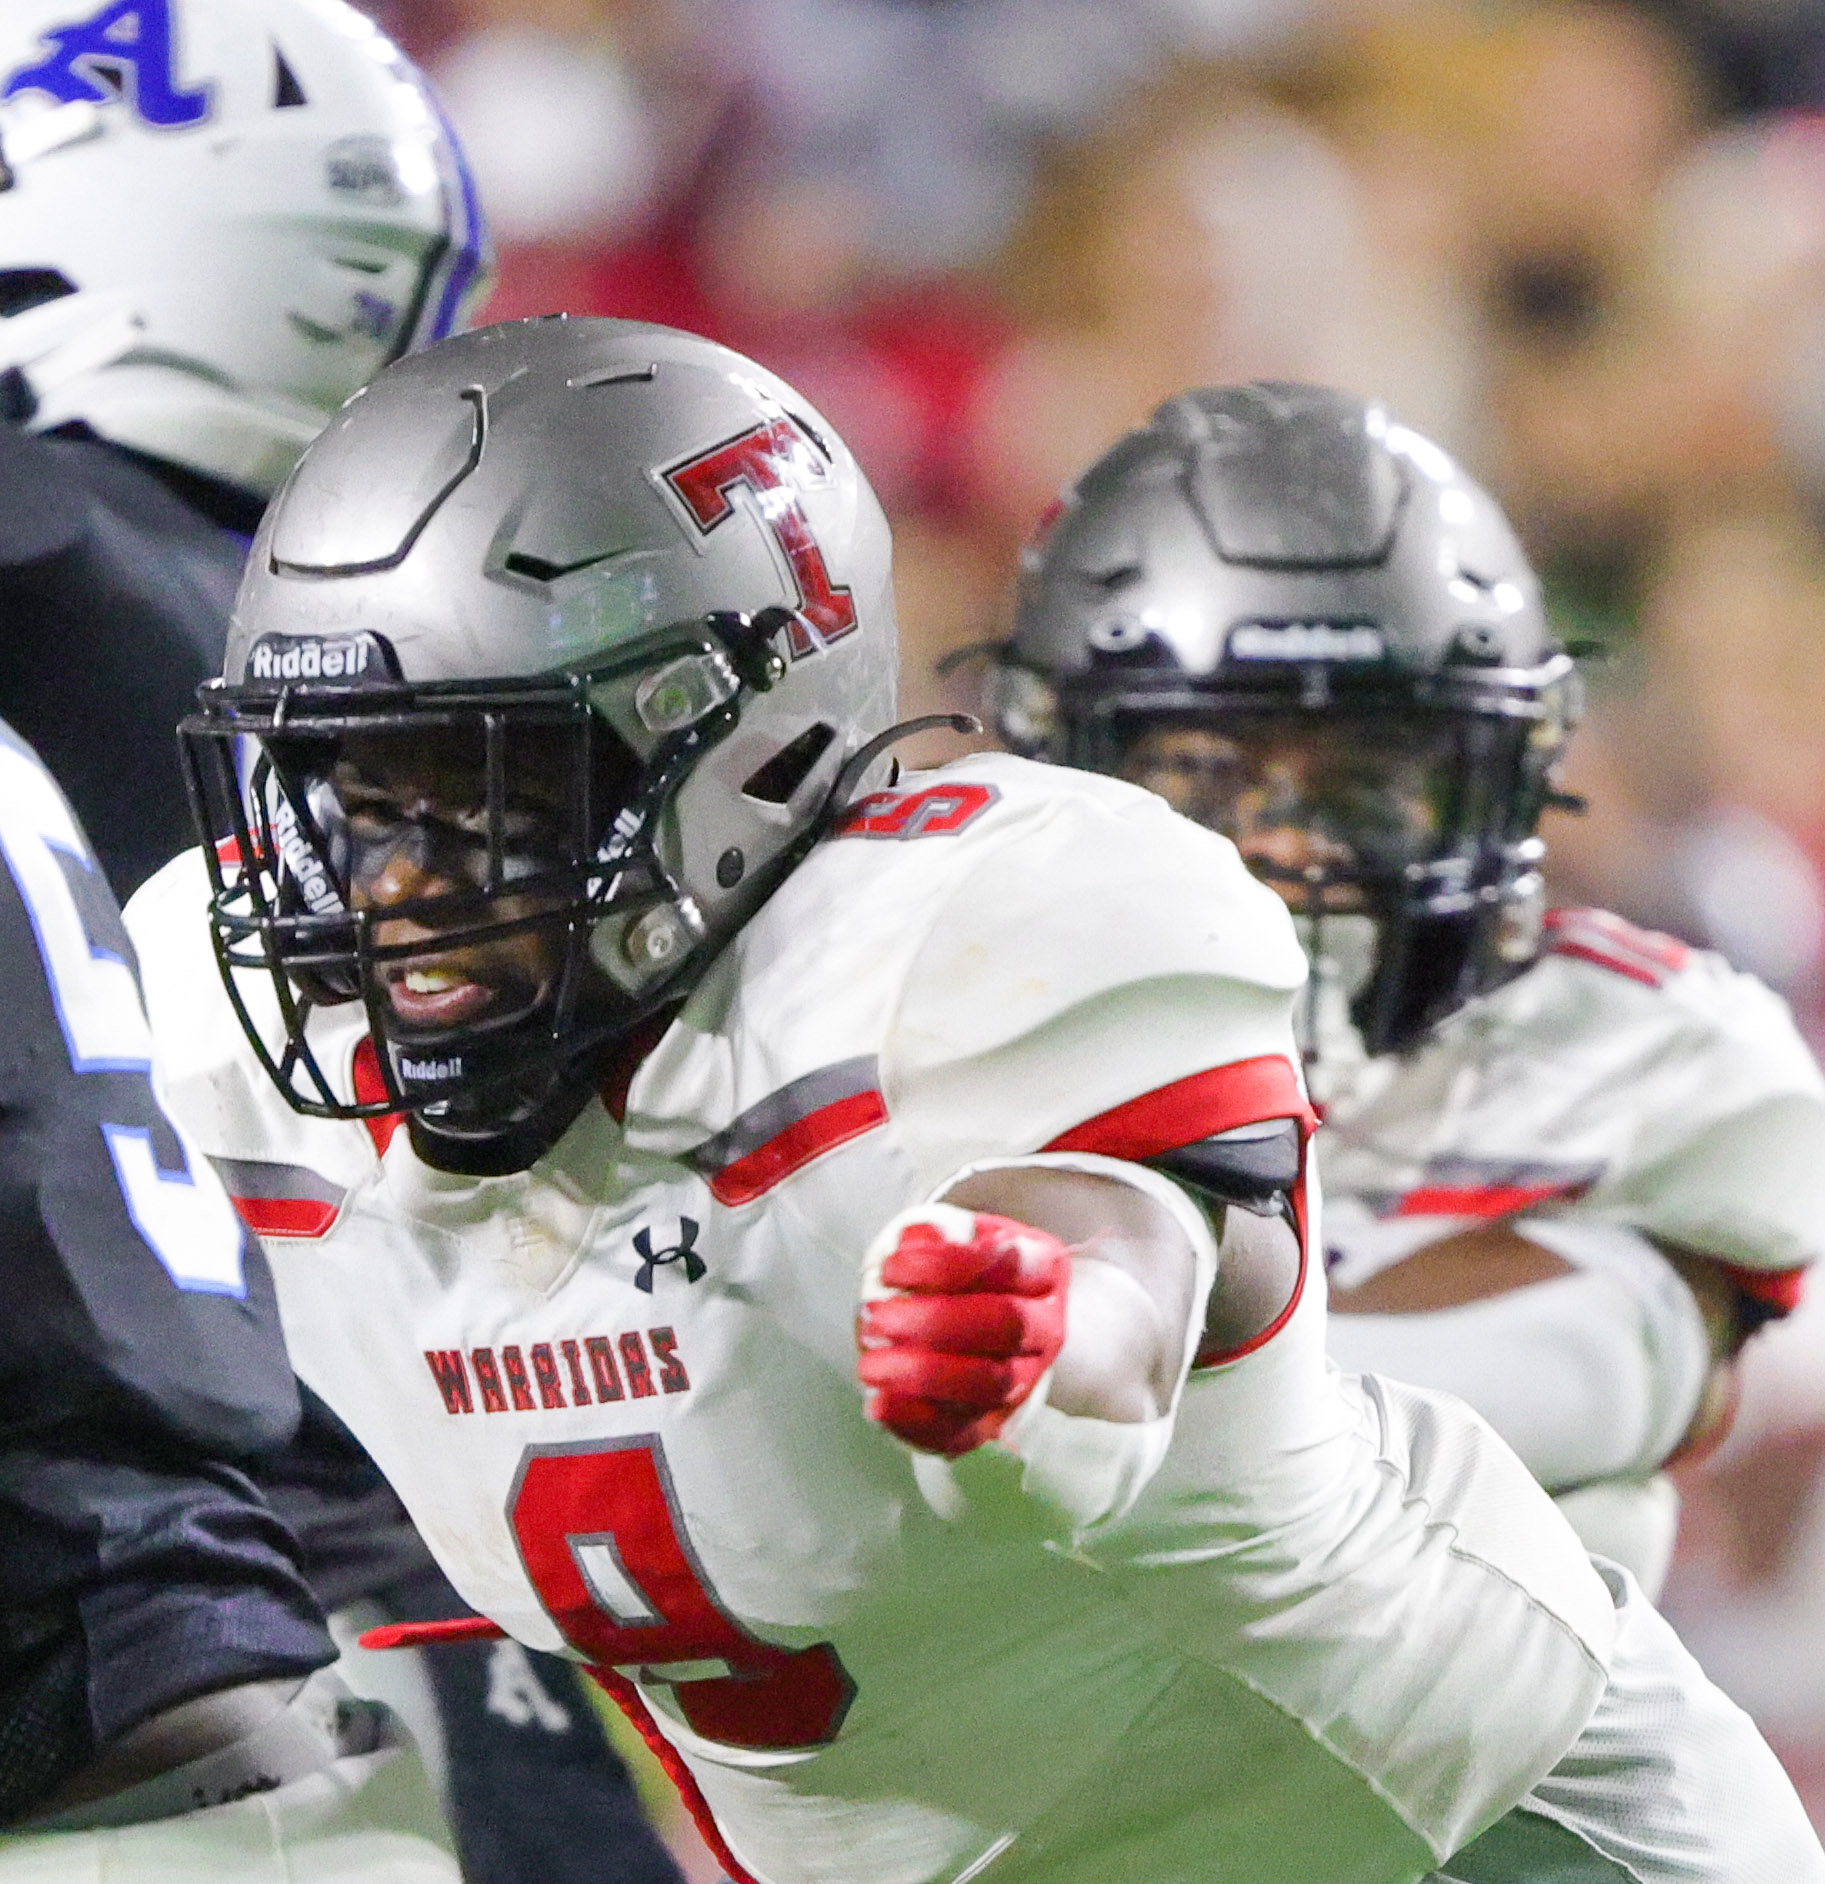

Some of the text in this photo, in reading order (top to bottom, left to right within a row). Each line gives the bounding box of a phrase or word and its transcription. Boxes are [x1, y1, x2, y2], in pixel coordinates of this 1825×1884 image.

[661, 417, 859, 663] T
[252, 635, 371, 679] Riddell
[276, 798, 345, 914] Riddell
[401, 1056, 462, 1080] Riddell
[423, 1325, 691, 1415] WARRIORS
[504, 1431, 859, 1750] 9
